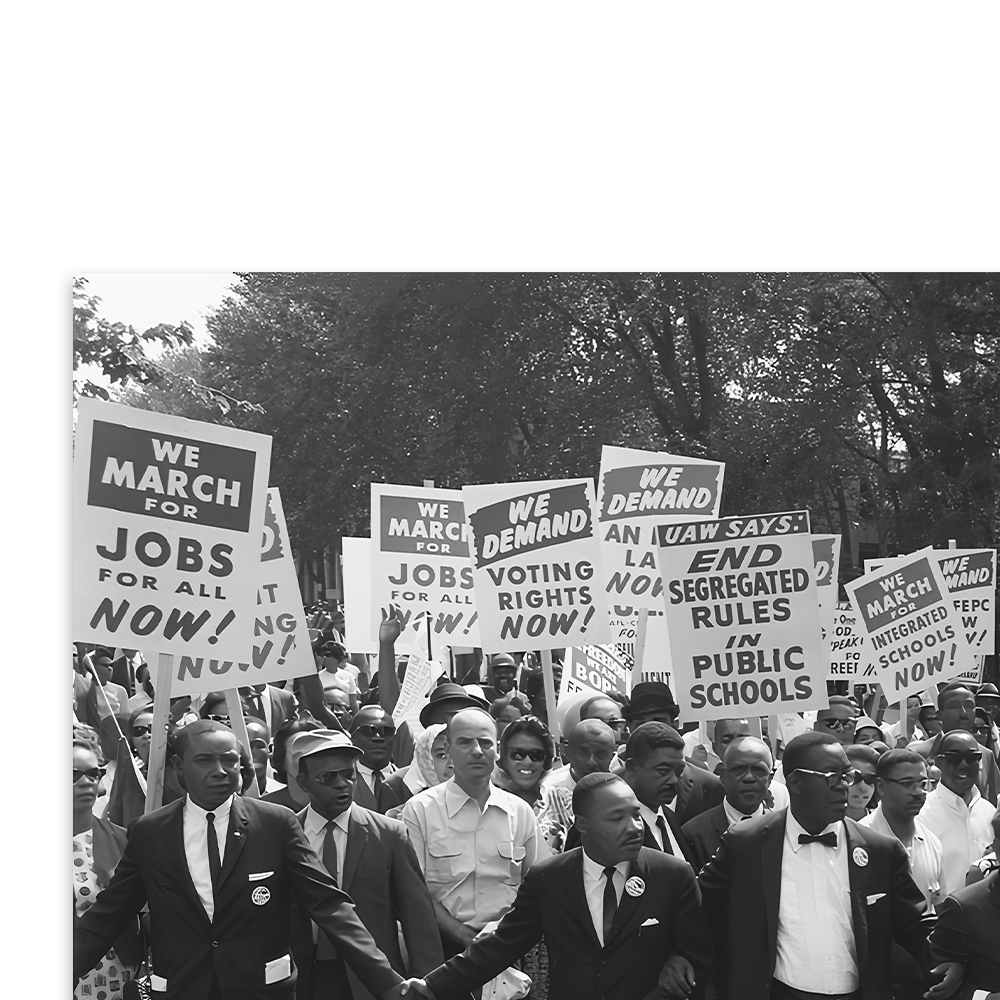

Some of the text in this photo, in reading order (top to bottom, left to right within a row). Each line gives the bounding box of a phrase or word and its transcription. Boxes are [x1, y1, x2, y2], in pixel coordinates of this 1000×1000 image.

[152, 438, 200, 468] WE
[101, 457, 241, 508] MARCH
[639, 466, 684, 490] WE
[144, 497, 198, 520] FOR
[417, 502, 449, 519] WE
[508, 493, 551, 524] WE
[607, 487, 712, 516] DEMAND
[416, 542, 451, 554] FOR
[482, 509, 588, 560] DEMAND
[604, 523, 641, 545] AN
[664, 522, 721, 545] UAW
[96, 526, 234, 577] JOBS
[625, 549, 656, 570] LA
[687, 543, 783, 574] END
[941, 556, 970, 575] WE
[98, 568, 227, 600] FOR ALL
[388, 563, 475, 590] JOBS
[486, 560, 594, 587] VOTING
[668, 567, 810, 605] SEGREGATED
[879, 572, 907, 592] WE
[944, 567, 990, 590] MAND
[391, 590, 473, 605] FOR ALL
[498, 586, 593, 611] RIGHTS
[866, 576, 933, 619] MARCH
[890, 602, 917, 619] FOR
[953, 599, 990, 613] FEPC
[89, 597, 236, 645] NOW!
[500, 605, 596, 641] NOW!
[690, 597, 792, 629] RULES
[870, 605, 948, 650] INTEGRATED
[725, 633, 762, 649] IN
[878, 625, 956, 669] SCHOOLS
[692, 646, 805, 679] PUBLIC
[895, 643, 957, 691] NOW!
[689, 675, 814, 709] SCHOOLS
